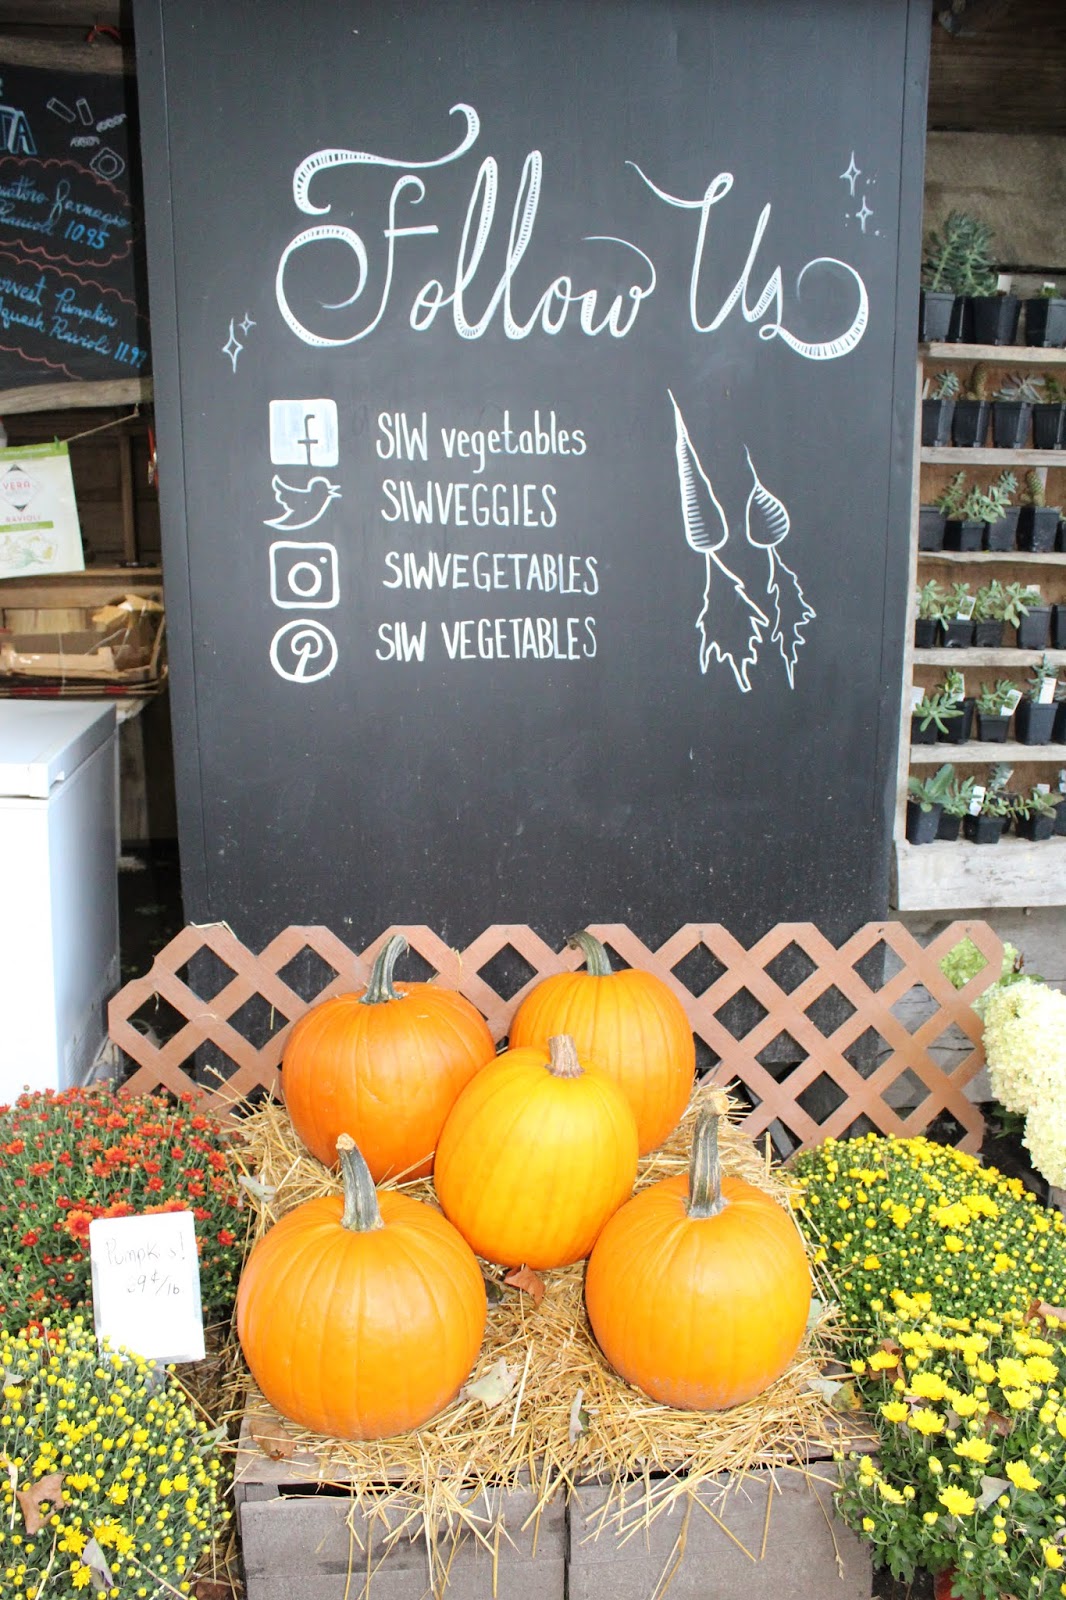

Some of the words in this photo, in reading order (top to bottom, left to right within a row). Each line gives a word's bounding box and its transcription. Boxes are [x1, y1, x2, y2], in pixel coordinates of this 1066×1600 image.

[64, 220, 110, 250] 10.95
[275, 103, 656, 348] Follow
[625, 160, 869, 361] Us
[376, 412, 428, 461] SIW
[440, 409, 588, 474] vegetables
[380, 479, 558, 528] SIWVEGGIES
[382, 551, 600, 596] SIWVEGETABLES
[375, 621, 427, 663] SIW
[440, 616, 598, 661] VEGETABLES
